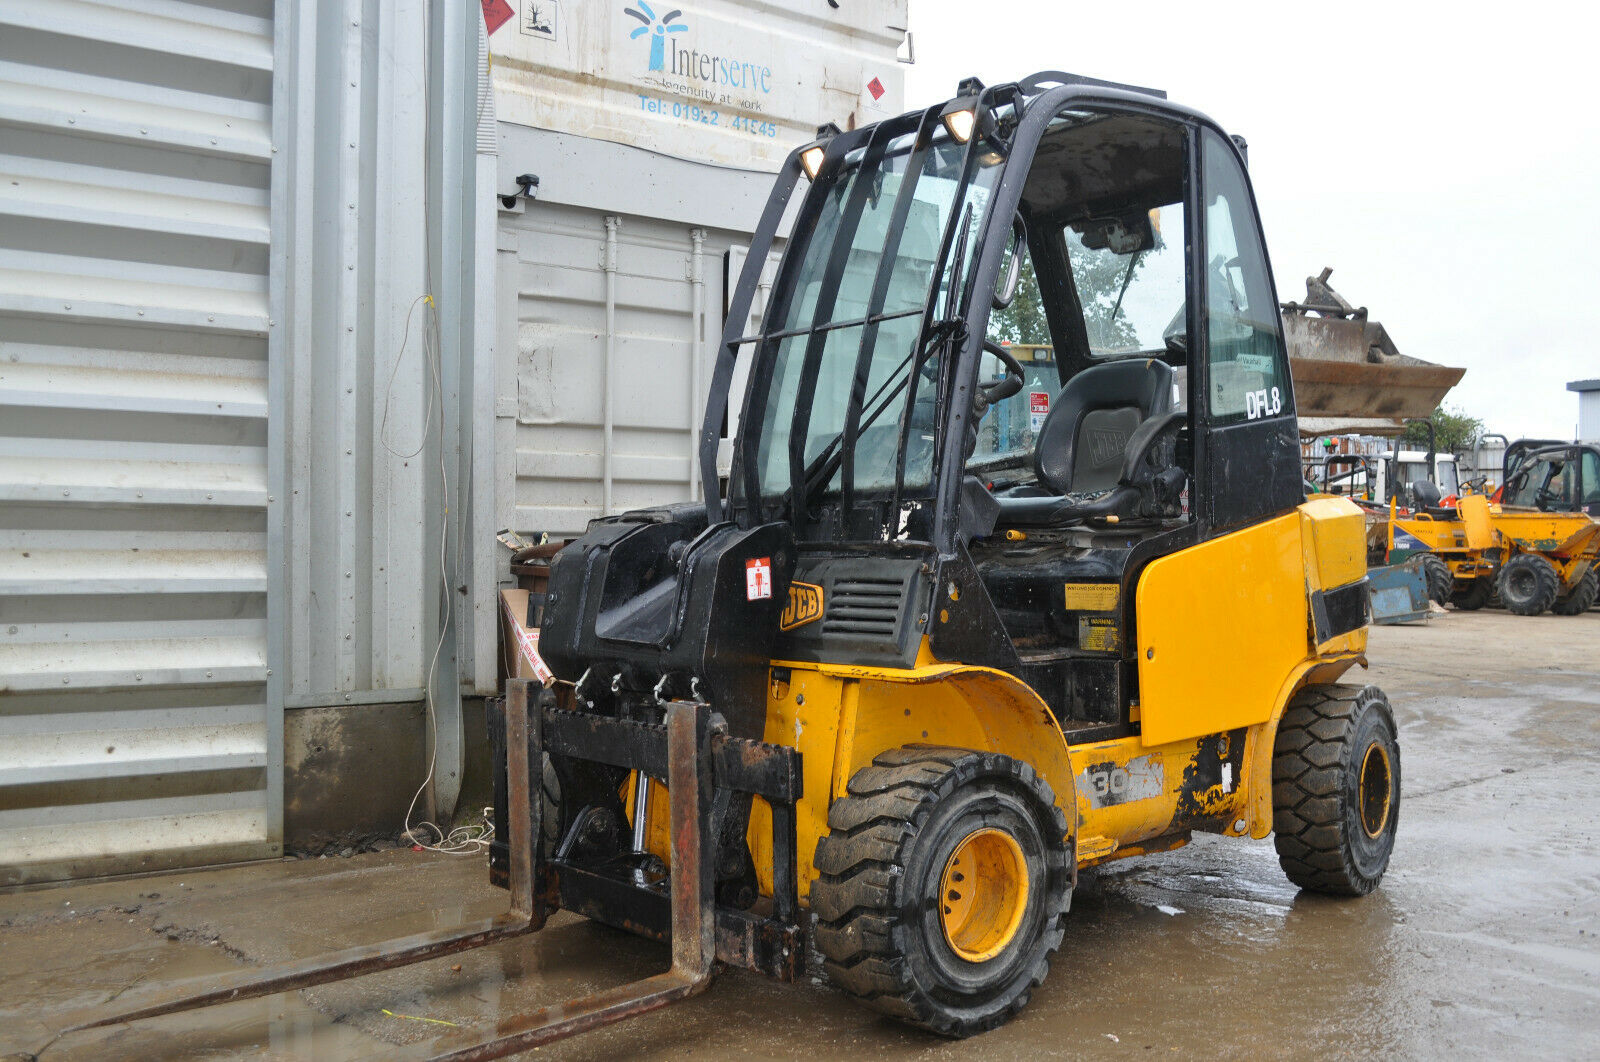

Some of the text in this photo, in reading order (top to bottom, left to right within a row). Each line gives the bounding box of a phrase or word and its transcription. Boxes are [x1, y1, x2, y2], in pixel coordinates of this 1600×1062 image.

[671, 38, 772, 93] Interserve
[638, 94, 667, 115] Tel:
[719, 93, 732, 104] at
[1246, 386, 1281, 420] DFL8
[784, 586, 818, 625] JCB
[1091, 768, 1129, 797] 30
